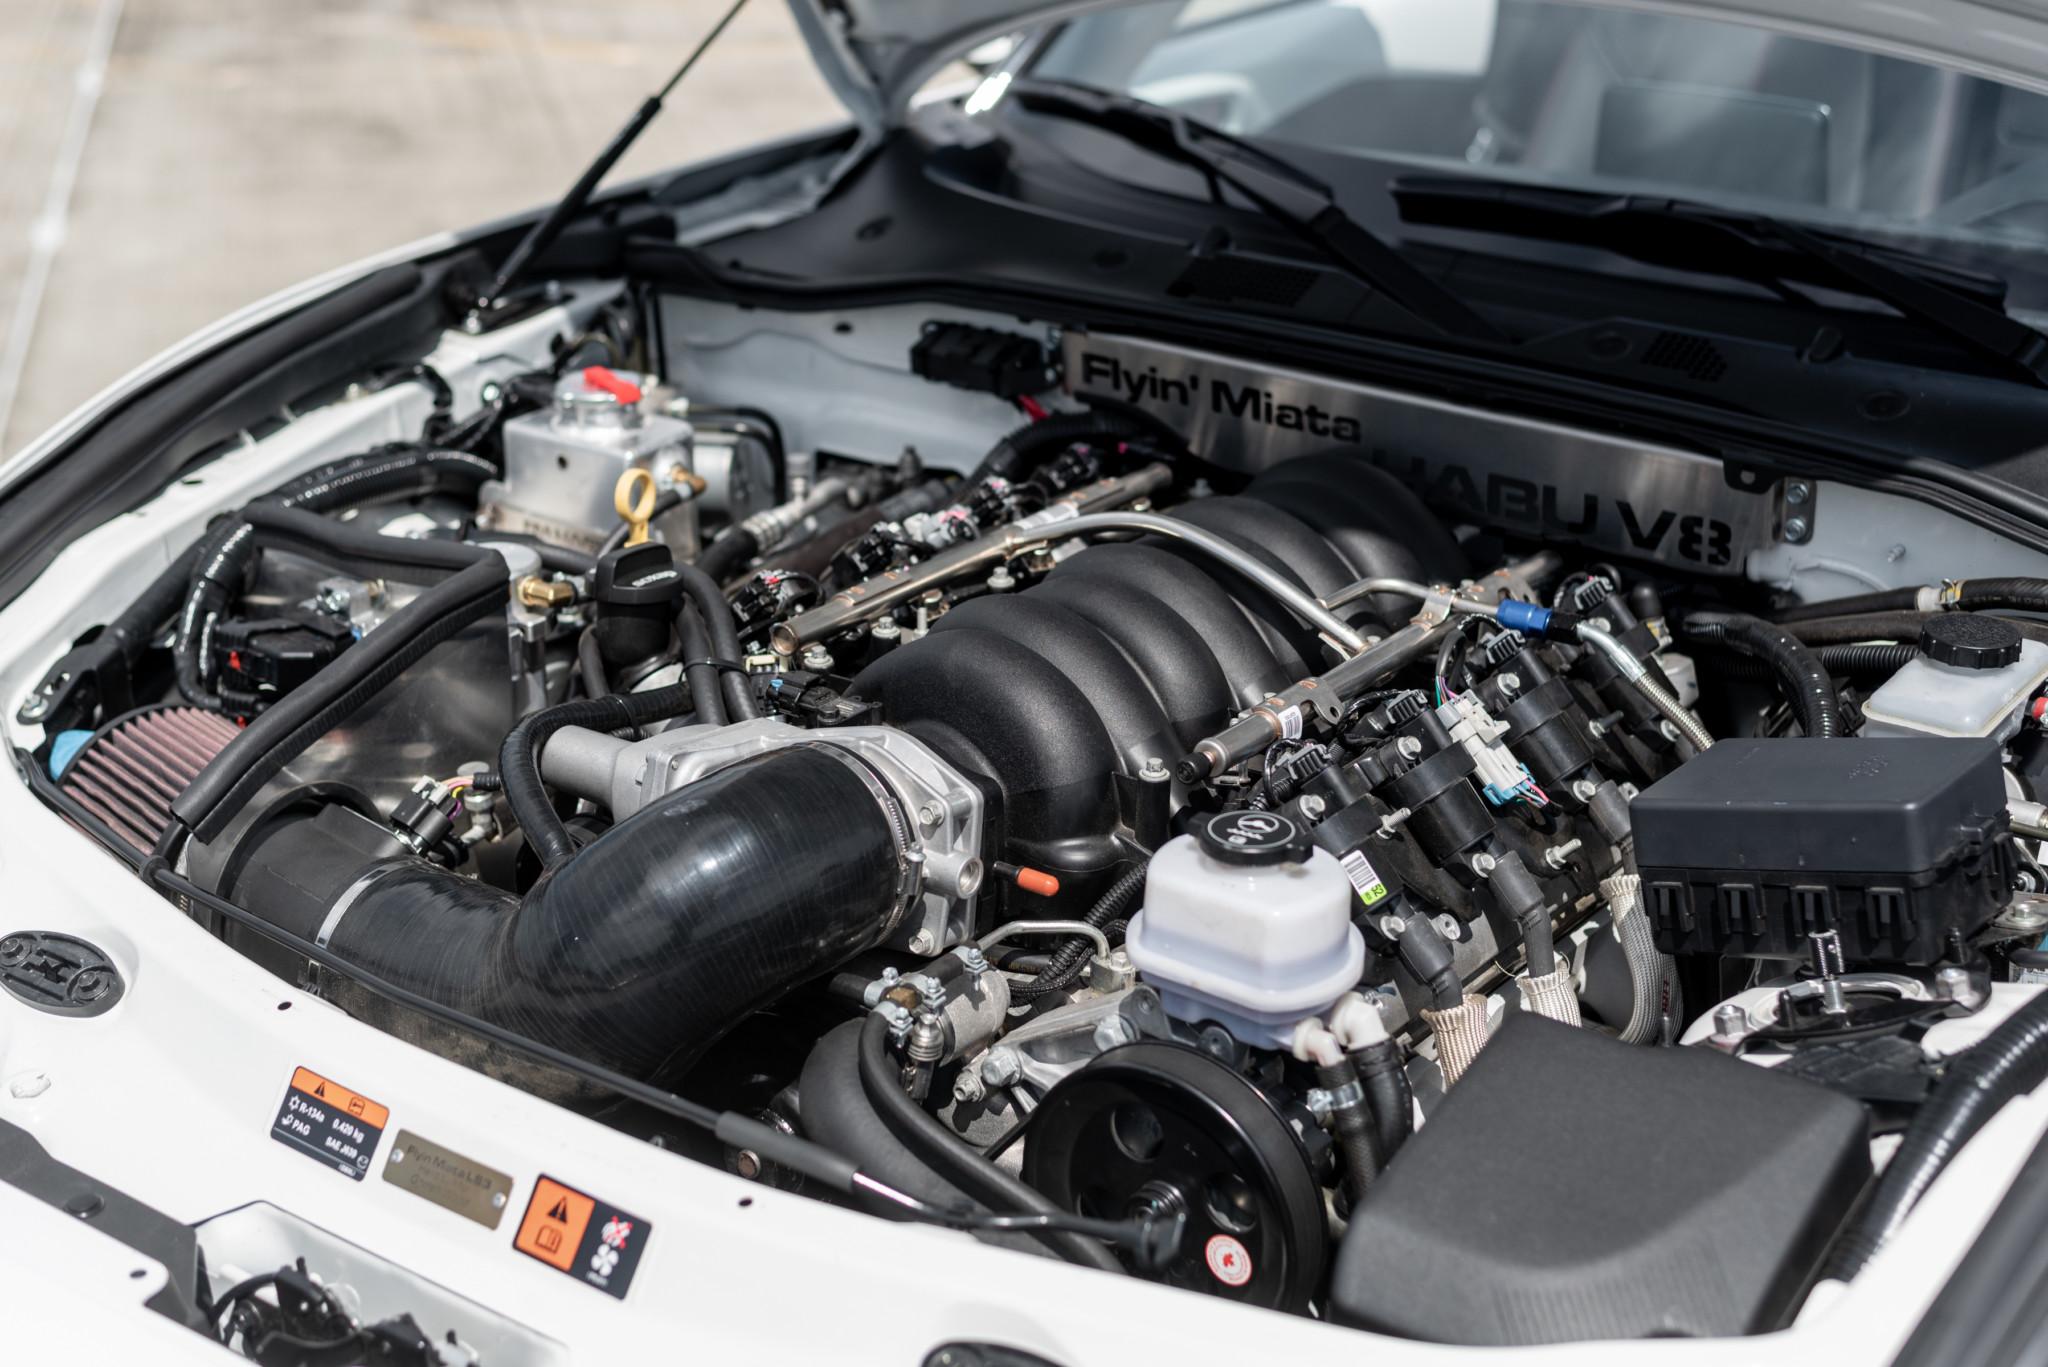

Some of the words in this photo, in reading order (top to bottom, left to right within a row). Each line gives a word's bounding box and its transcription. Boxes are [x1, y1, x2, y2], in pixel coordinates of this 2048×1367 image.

[1081, 352, 1199, 403] Flyin'
[1210, 380, 1361, 443] Miata
[1615, 499, 1732, 566] V8
[298, 1101, 326, 1123] R-134a
[292, 1119, 311, 1136] PAG
[324, 1135, 342, 1152] SAE
